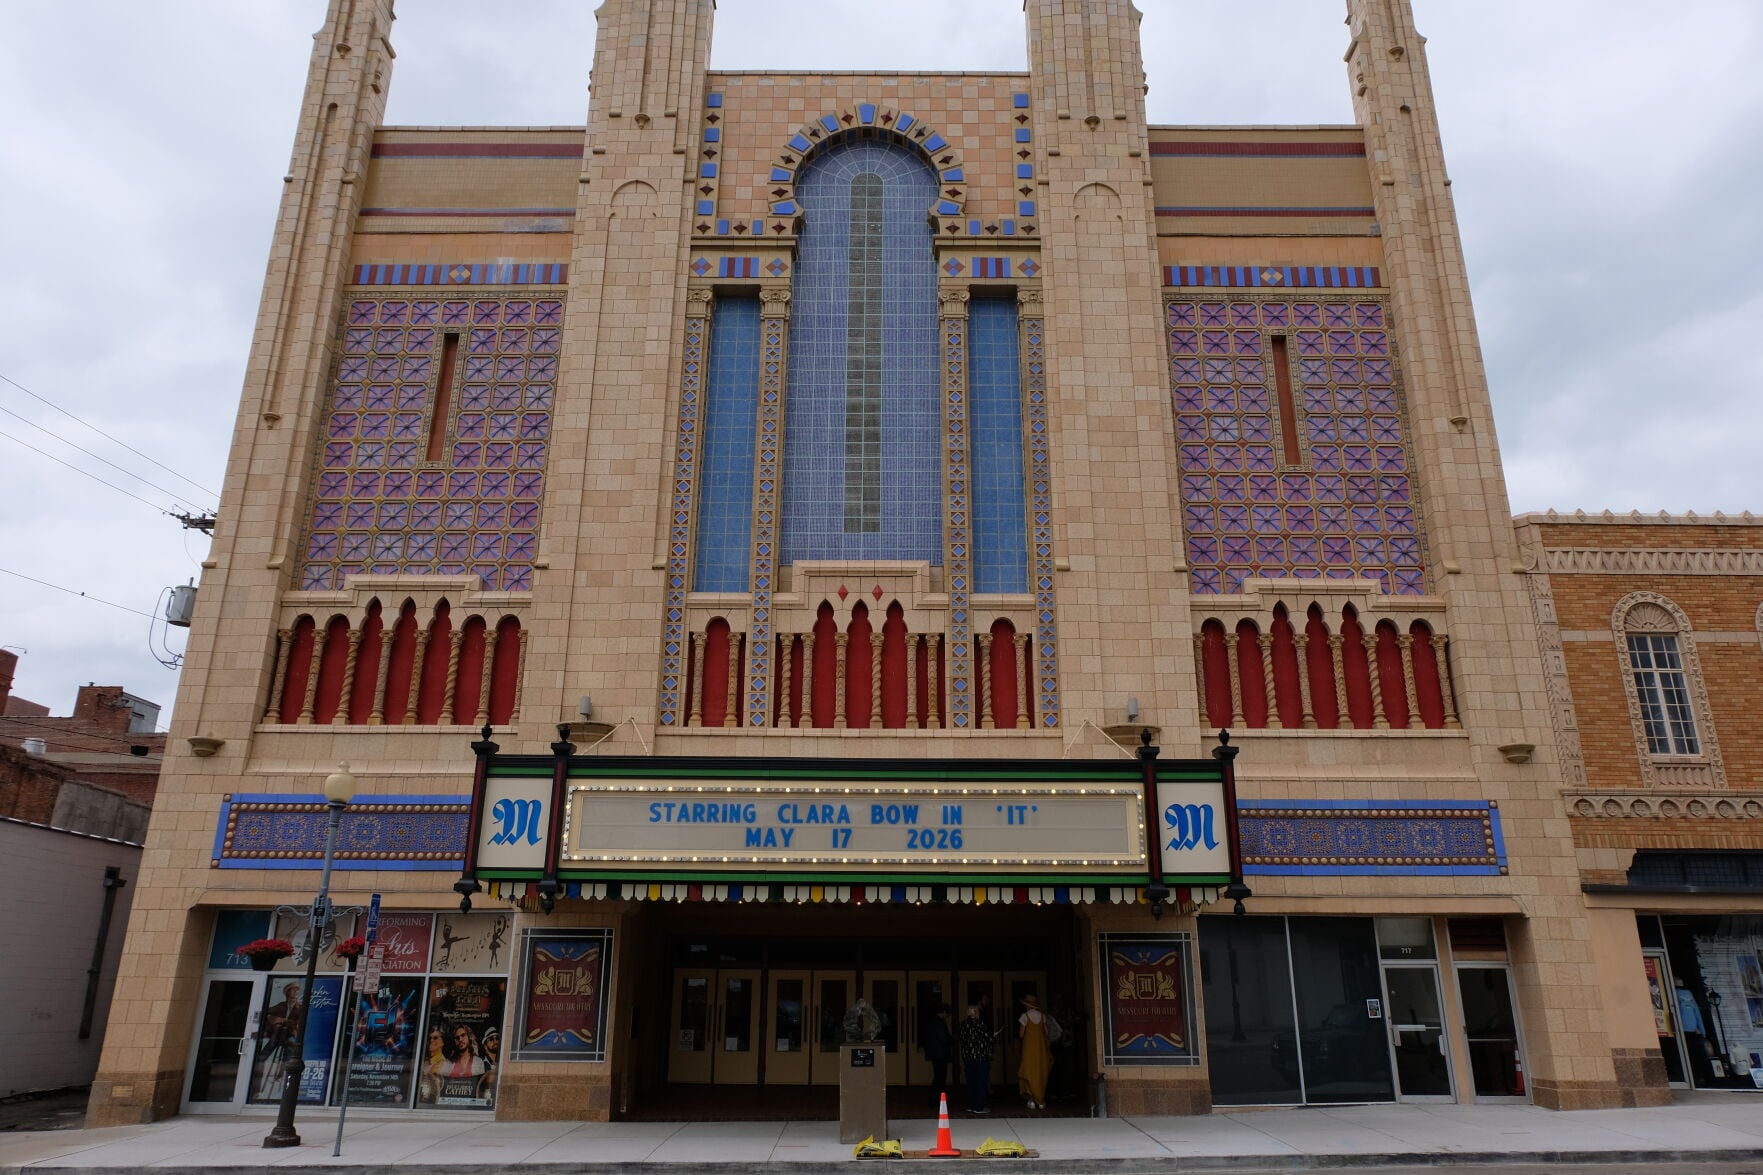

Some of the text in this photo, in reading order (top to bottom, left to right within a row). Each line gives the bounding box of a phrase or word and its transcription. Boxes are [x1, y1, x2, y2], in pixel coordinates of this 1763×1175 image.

[649, 803, 757, 823] STARRING
[777, 803, 851, 824] CLARA
[871, 805, 919, 825] BOW
[943, 805, 963, 825] IN
[745, 828, 963, 849] MAY 17 2026
[377, 917, 426, 926] RFORMING
[377, 925, 420, 960] Arts
[1401, 947, 1412, 955] 717
[226, 953, 249, 965] 713
[382, 960, 422, 970] CIATION
[351, 1062, 376, 1072] oreigner
[381, 1063, 404, 1073] Journey
